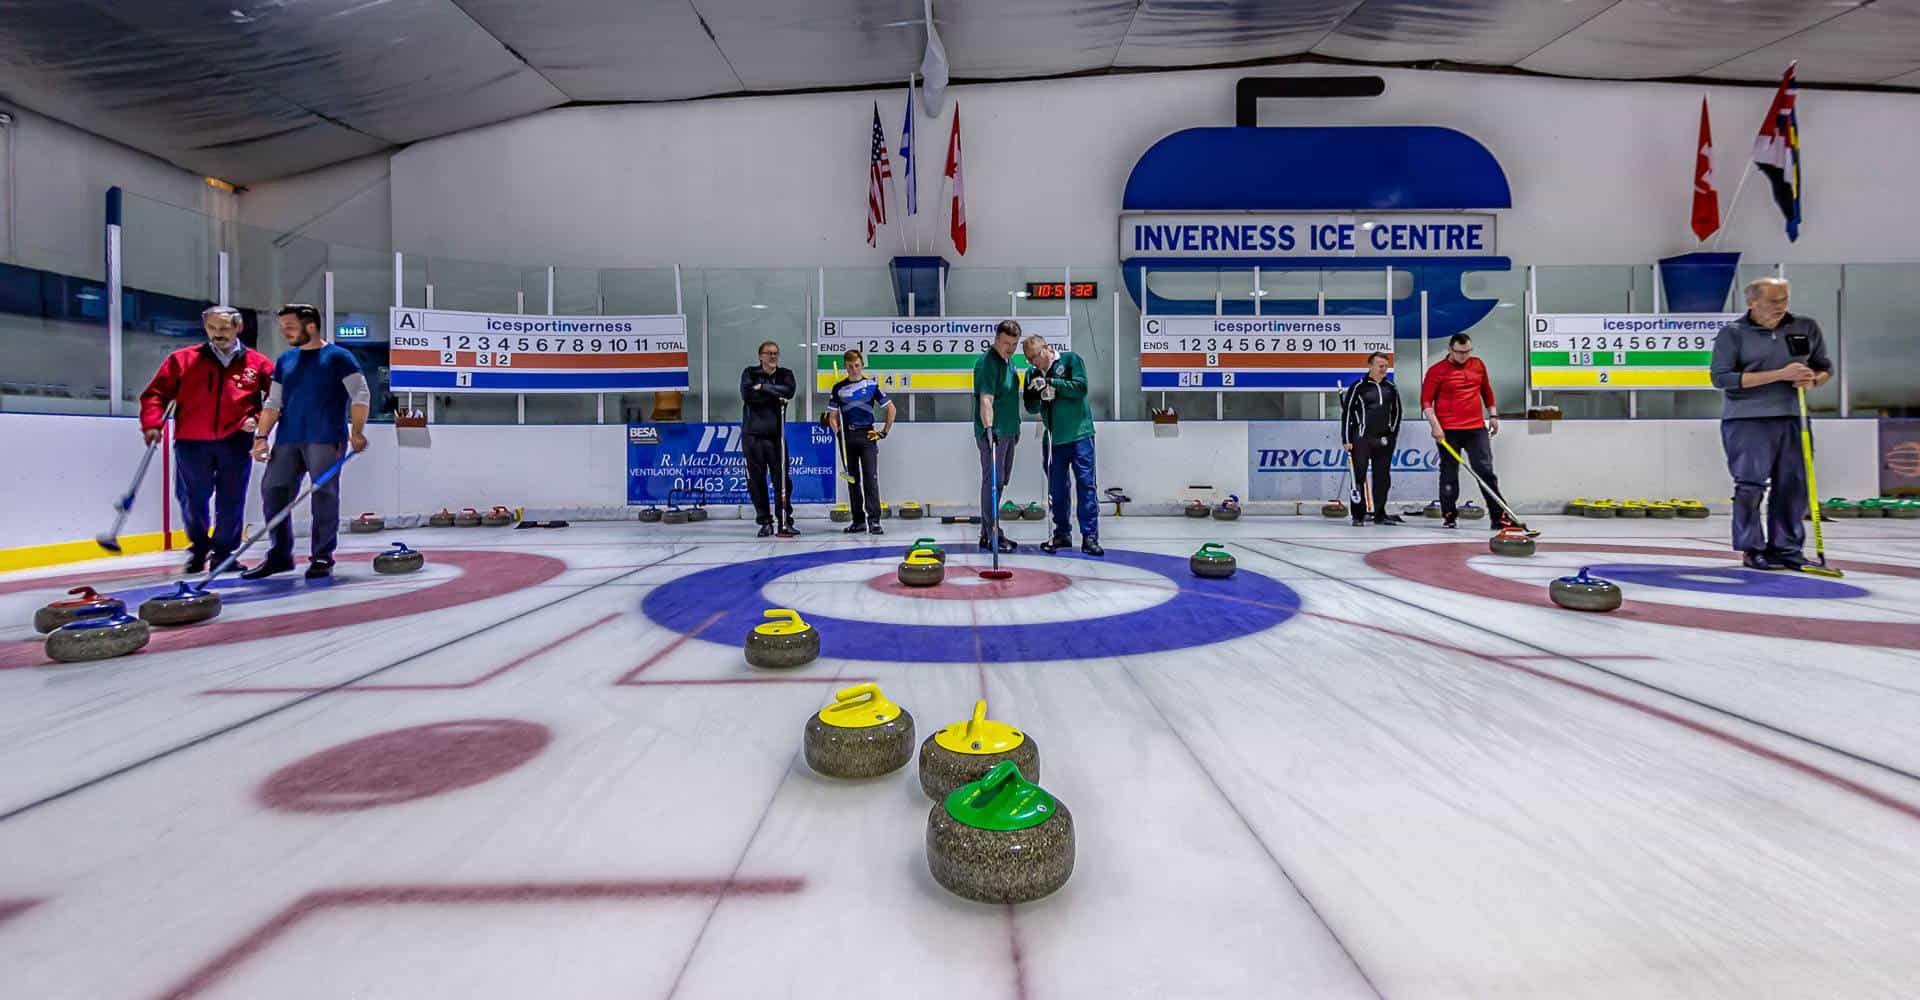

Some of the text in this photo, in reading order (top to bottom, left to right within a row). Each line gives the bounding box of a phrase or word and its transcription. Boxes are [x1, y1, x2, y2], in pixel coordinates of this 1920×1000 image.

[1135, 224, 1483, 251] INVERNESS ICE CENTRE
[1038, 284, 1093, 297] 10:5:32
[400, 313, 415, 329] A
[487, 318, 632, 334] icesportinverness
[1147, 320, 1159, 334] C
[1536, 320, 1548, 332] D
[824, 322, 836, 336] B
[892, 322, 1000, 336] icesportinverne
[1214, 320, 1341, 335] icesportinverness
[394, 336, 685, 352] ENDS 1 2 3 4 5 6 7 8 9 10 11 TOTAL
[820, 344, 846, 352] ENDS
[857, 340, 863, 352] 1
[869, 340, 878, 352] 2
[885, 340, 894, 352] 3
[900, 340, 910, 352] 4
[917, 340, 927, 352] 5
[933, 340, 943, 352] 6
[950, 340, 958, 352] 7
[964, 340, 974, 352] 8
[981, 340, 990, 352] 9
[1144, 339, 1391, 351] ENDS 1 2 3 4 5 6 7 8 9 10 11 TOTAL
[1533, 337, 1704, 349] ENDS 1 2 3 4 5 6 7 8 9
[444, 352, 508, 365] 2 3 2
[1208, 355, 1216, 365] 3
[1572, 353, 1622, 364] 1 3 1
[460, 374, 468, 386] 1
[1194, 375, 1198, 384] 1
[1224, 374, 1232, 384] 2
[1600, 373, 1608, 383] 2
[630, 427, 658, 438] BESA
[812, 435, 833, 444] 1909
[660, 453, 673, 466] R.
[680, 453, 745, 466] MacDona
[630, 468, 684, 476] VENTILATION,
[687, 467, 722, 476] HEATING
[724, 467, 730, 475] &
[674, 477, 748, 491] 01463 23
